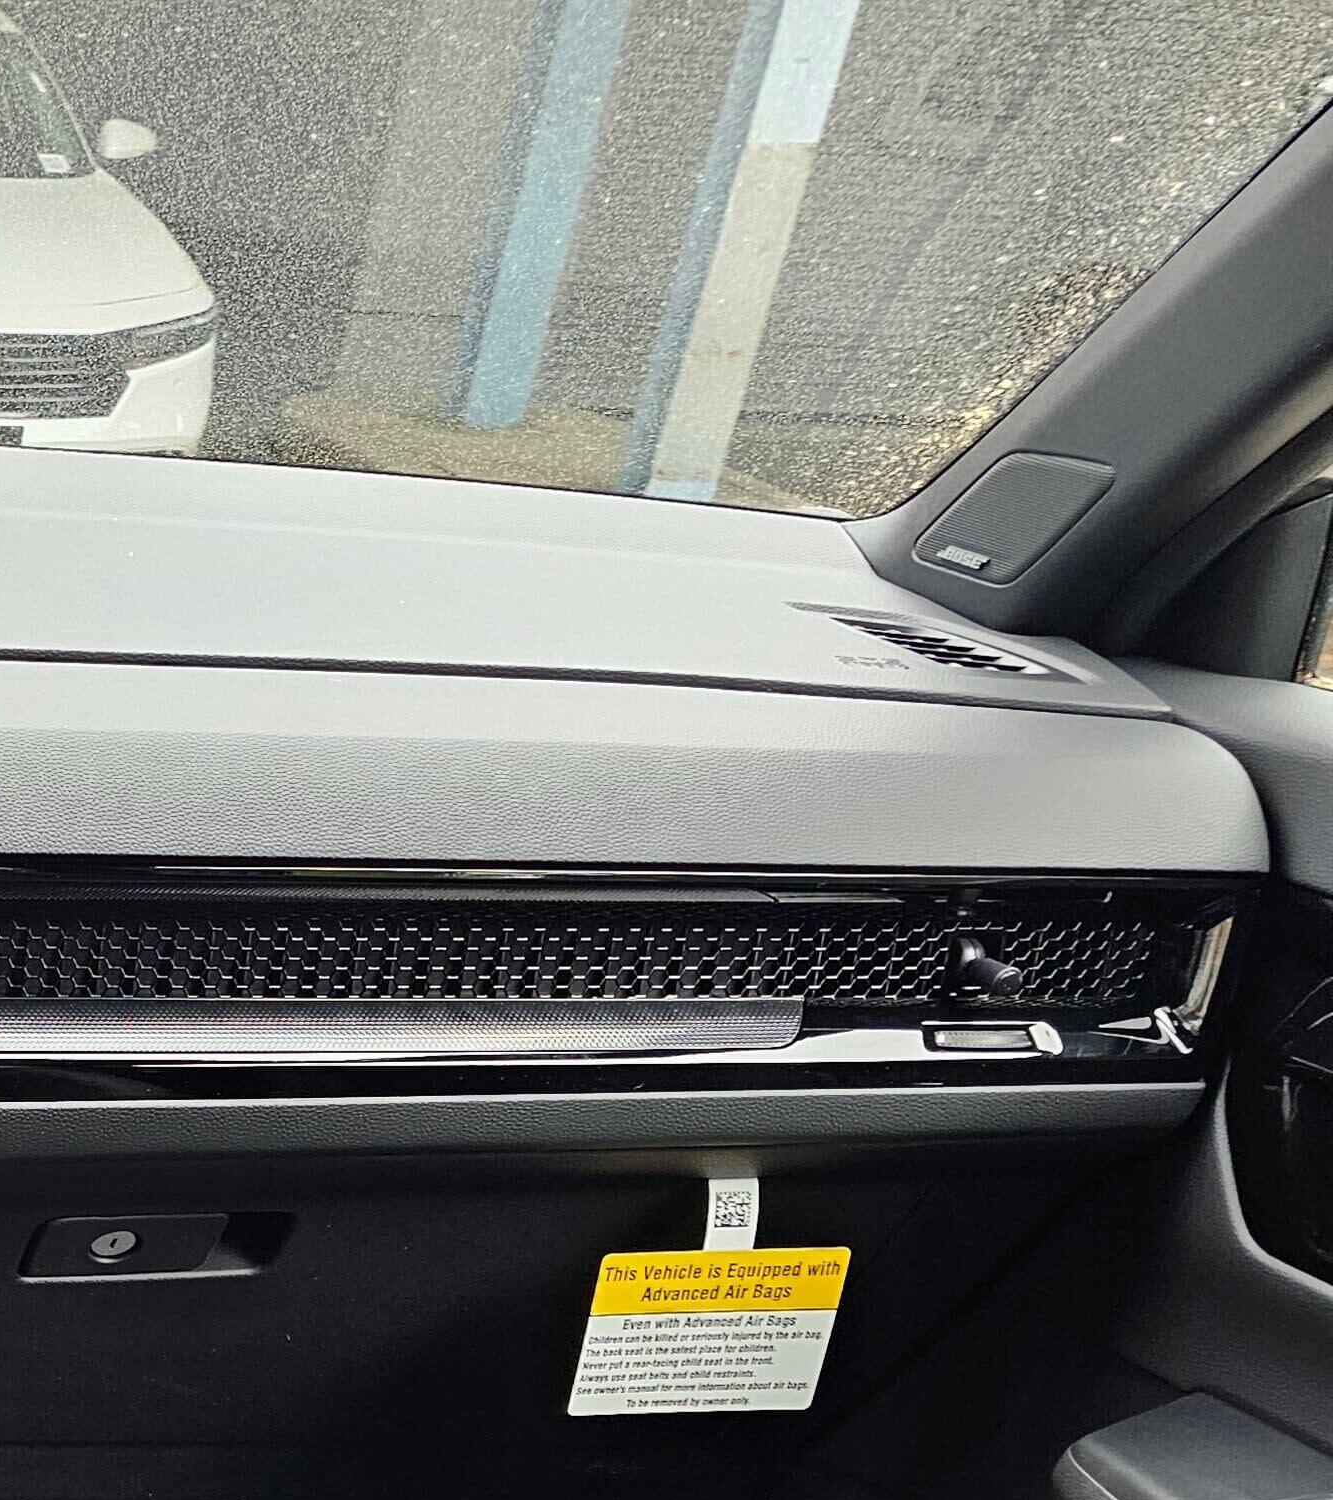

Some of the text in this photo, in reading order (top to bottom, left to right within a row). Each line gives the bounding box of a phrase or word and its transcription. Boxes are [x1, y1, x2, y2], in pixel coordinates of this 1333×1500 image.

[945, 546, 983, 567] BOSE
[605, 1260, 841, 1282] This Vehicle is Equipped with
[641, 1284, 793, 1302] Advanced Air Bags
[622, 1315, 797, 1330] Even with Advanced Air Bags
[588, 1335, 623, 1345] Children
[625, 1336, 640, 1344] can
[642, 1334, 653, 1343] be
[654, 1333, 679, 1343] killed
[691, 1332, 729, 1342] seriously
[731, 1331, 762, 1342] injured
[763, 1332, 773, 1341] by
[775, 1331, 789, 1339] the
[791, 1331, 803, 1339] air
[585, 1348, 601, 1357] The
[603, 1348, 623, 1357] back
[625, 1347, 644, 1356] seat
[645, 1347, 653, 1355] is
[655, 1346, 669, 1355] the
[670, 1345, 697, 1355] safest
[699, 1345, 722, 1354] place
[724, 1345, 737, 1353] for
[583, 1361, 609, 1370] Never
[608, 1361, 623, 1370] put
[681, 1358, 703, 1367] child
[704, 1357, 723, 1366] seat
[724, 1357, 733, 1366] in
[735, 1357, 749, 1365] the
[580, 1374, 608, 1383] Always
[611, 1374, 626, 1382] use
[628, 1373, 647, 1381] seat
[649, 1372, 669, 1380] belts
[672, 1371, 688, 1380] and
[689, 1370, 711, 1379] child
[576, 1387, 592, 1395] See
[627, 1384, 660, 1393] manual
[660, 1384, 673, 1392] for
[674, 1384, 696, 1392] more
[697, 1382, 746, 1391] information
[747, 1381, 772, 1390] about
[773, 1381, 785, 1389] air
[626, 1399, 636, 1408] To
[638, 1399, 649, 1407] be
[689, 1398, 700, 1408] by
